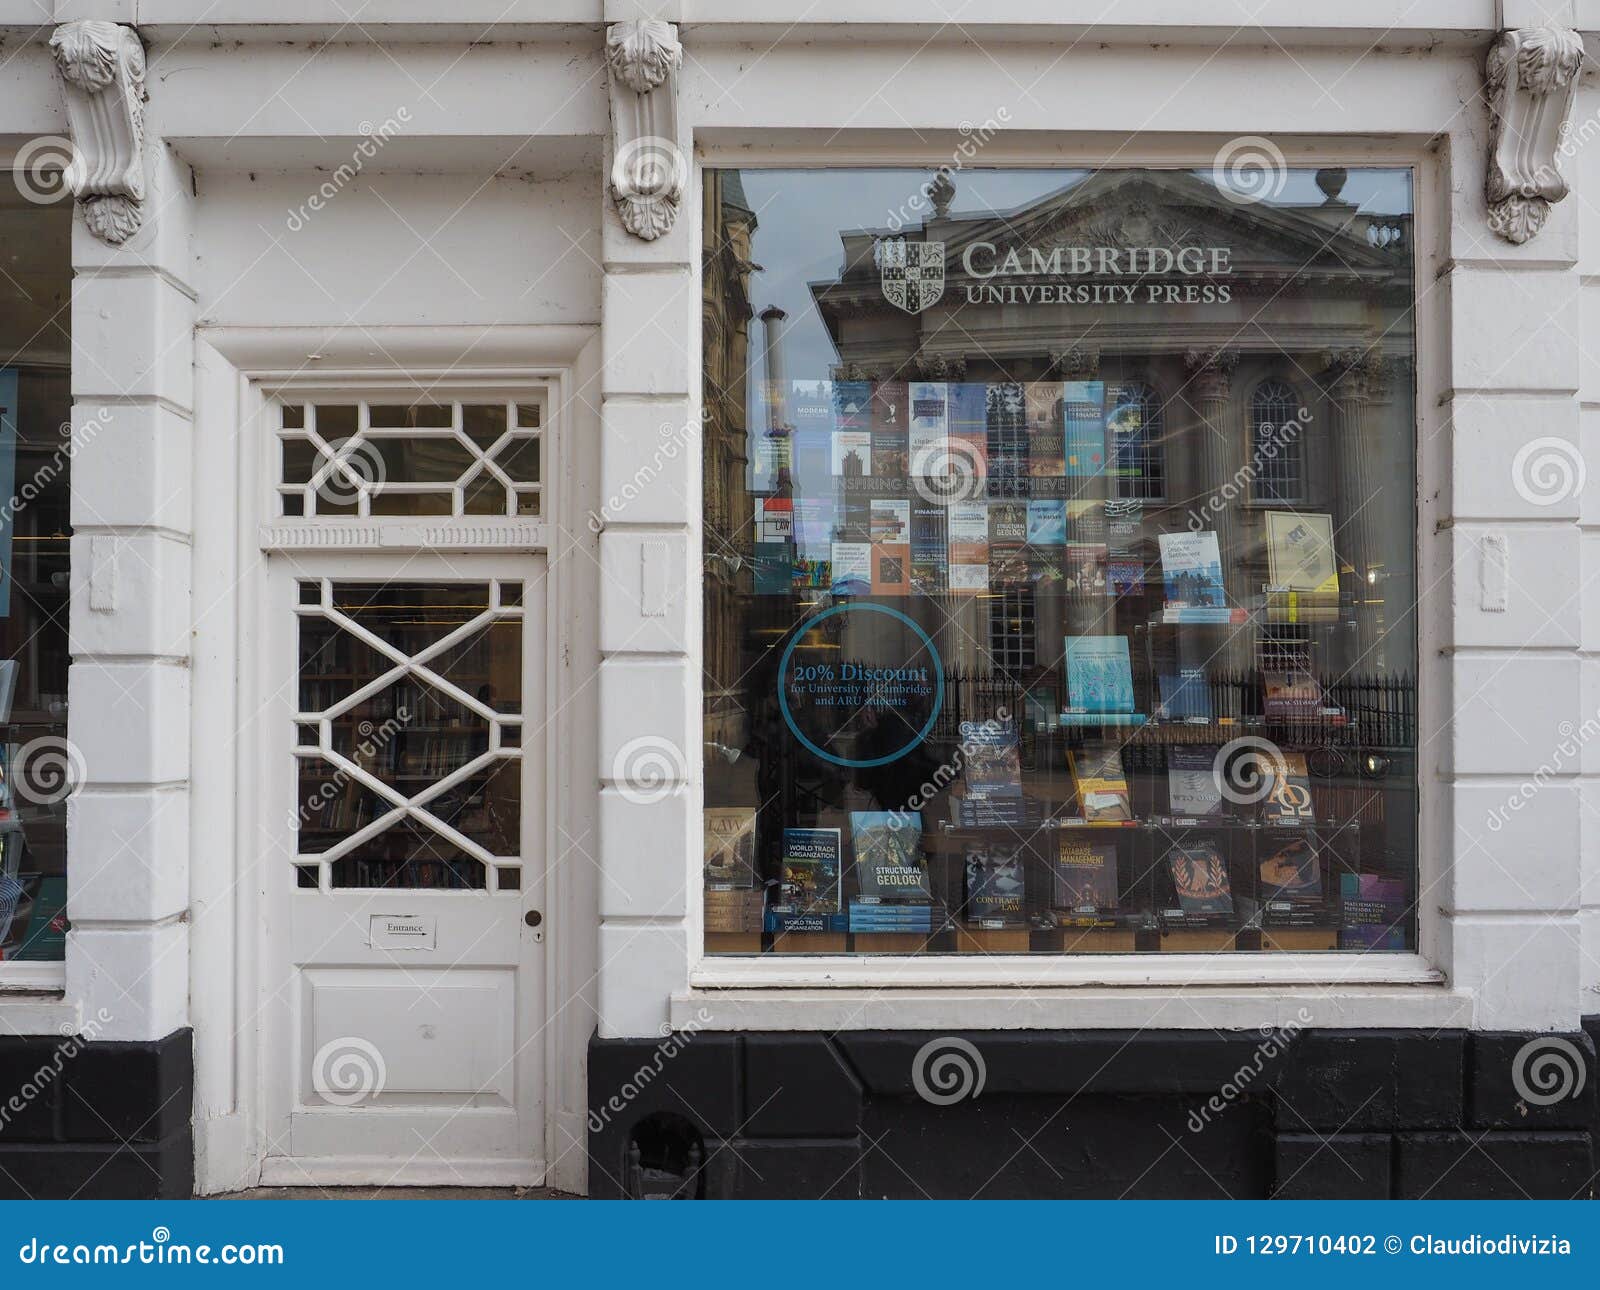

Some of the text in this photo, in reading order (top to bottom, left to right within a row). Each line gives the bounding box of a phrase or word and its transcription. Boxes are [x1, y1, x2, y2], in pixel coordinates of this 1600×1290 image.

[962, 241, 1233, 278] CAMBRIDGE
[965, 284, 1232, 304] UNIVERSITY PRESS
[794, 663, 928, 682] 20% Discount
[791, 683, 933, 696] for University of Cambridge
[815, 696, 907, 706] and ARU students
[708, 818, 743, 831] LAW
[789, 844, 812, 852] WORLD
[1060, 847, 1091, 855] DATABASE
[789, 851, 835, 859] ORGANIZATION
[1060, 855, 1104, 865] MANAGEMENT
[875, 867, 921, 875] STRUCTURAL
[877, 875, 922, 885] GEOLOGY
[976, 896, 1020, 904] CONTRACT
[387, 922, 424, 933] Entrance
